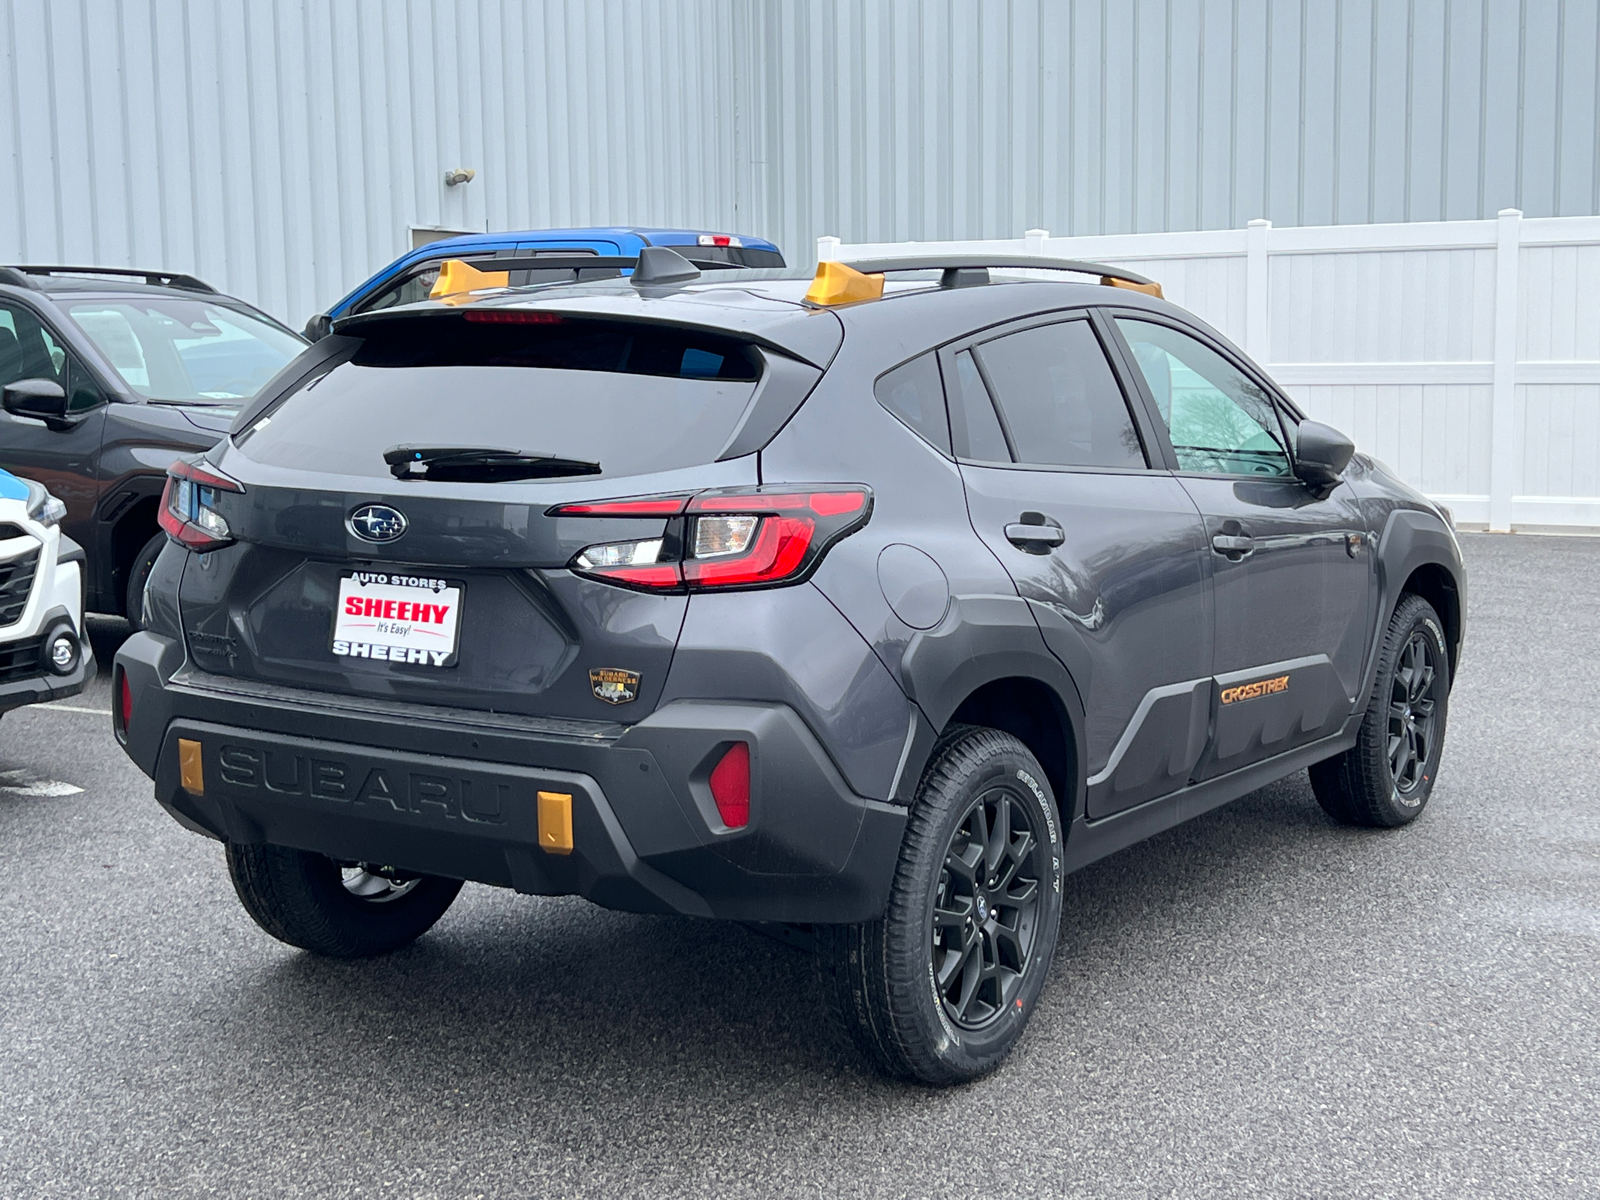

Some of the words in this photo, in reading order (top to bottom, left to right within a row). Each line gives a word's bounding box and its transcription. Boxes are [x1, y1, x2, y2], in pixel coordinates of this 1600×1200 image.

[351, 572, 388, 584] AUTO
[391, 576, 447, 589] STORES
[345, 596, 451, 624] SHEEHY
[377, 622, 389, 633] It's
[390, 623, 412, 637] Easy!
[332, 640, 452, 667] SHEEHY
[1221, 675, 1290, 704] CROSSTREK
[220, 744, 511, 826] SUBARU
